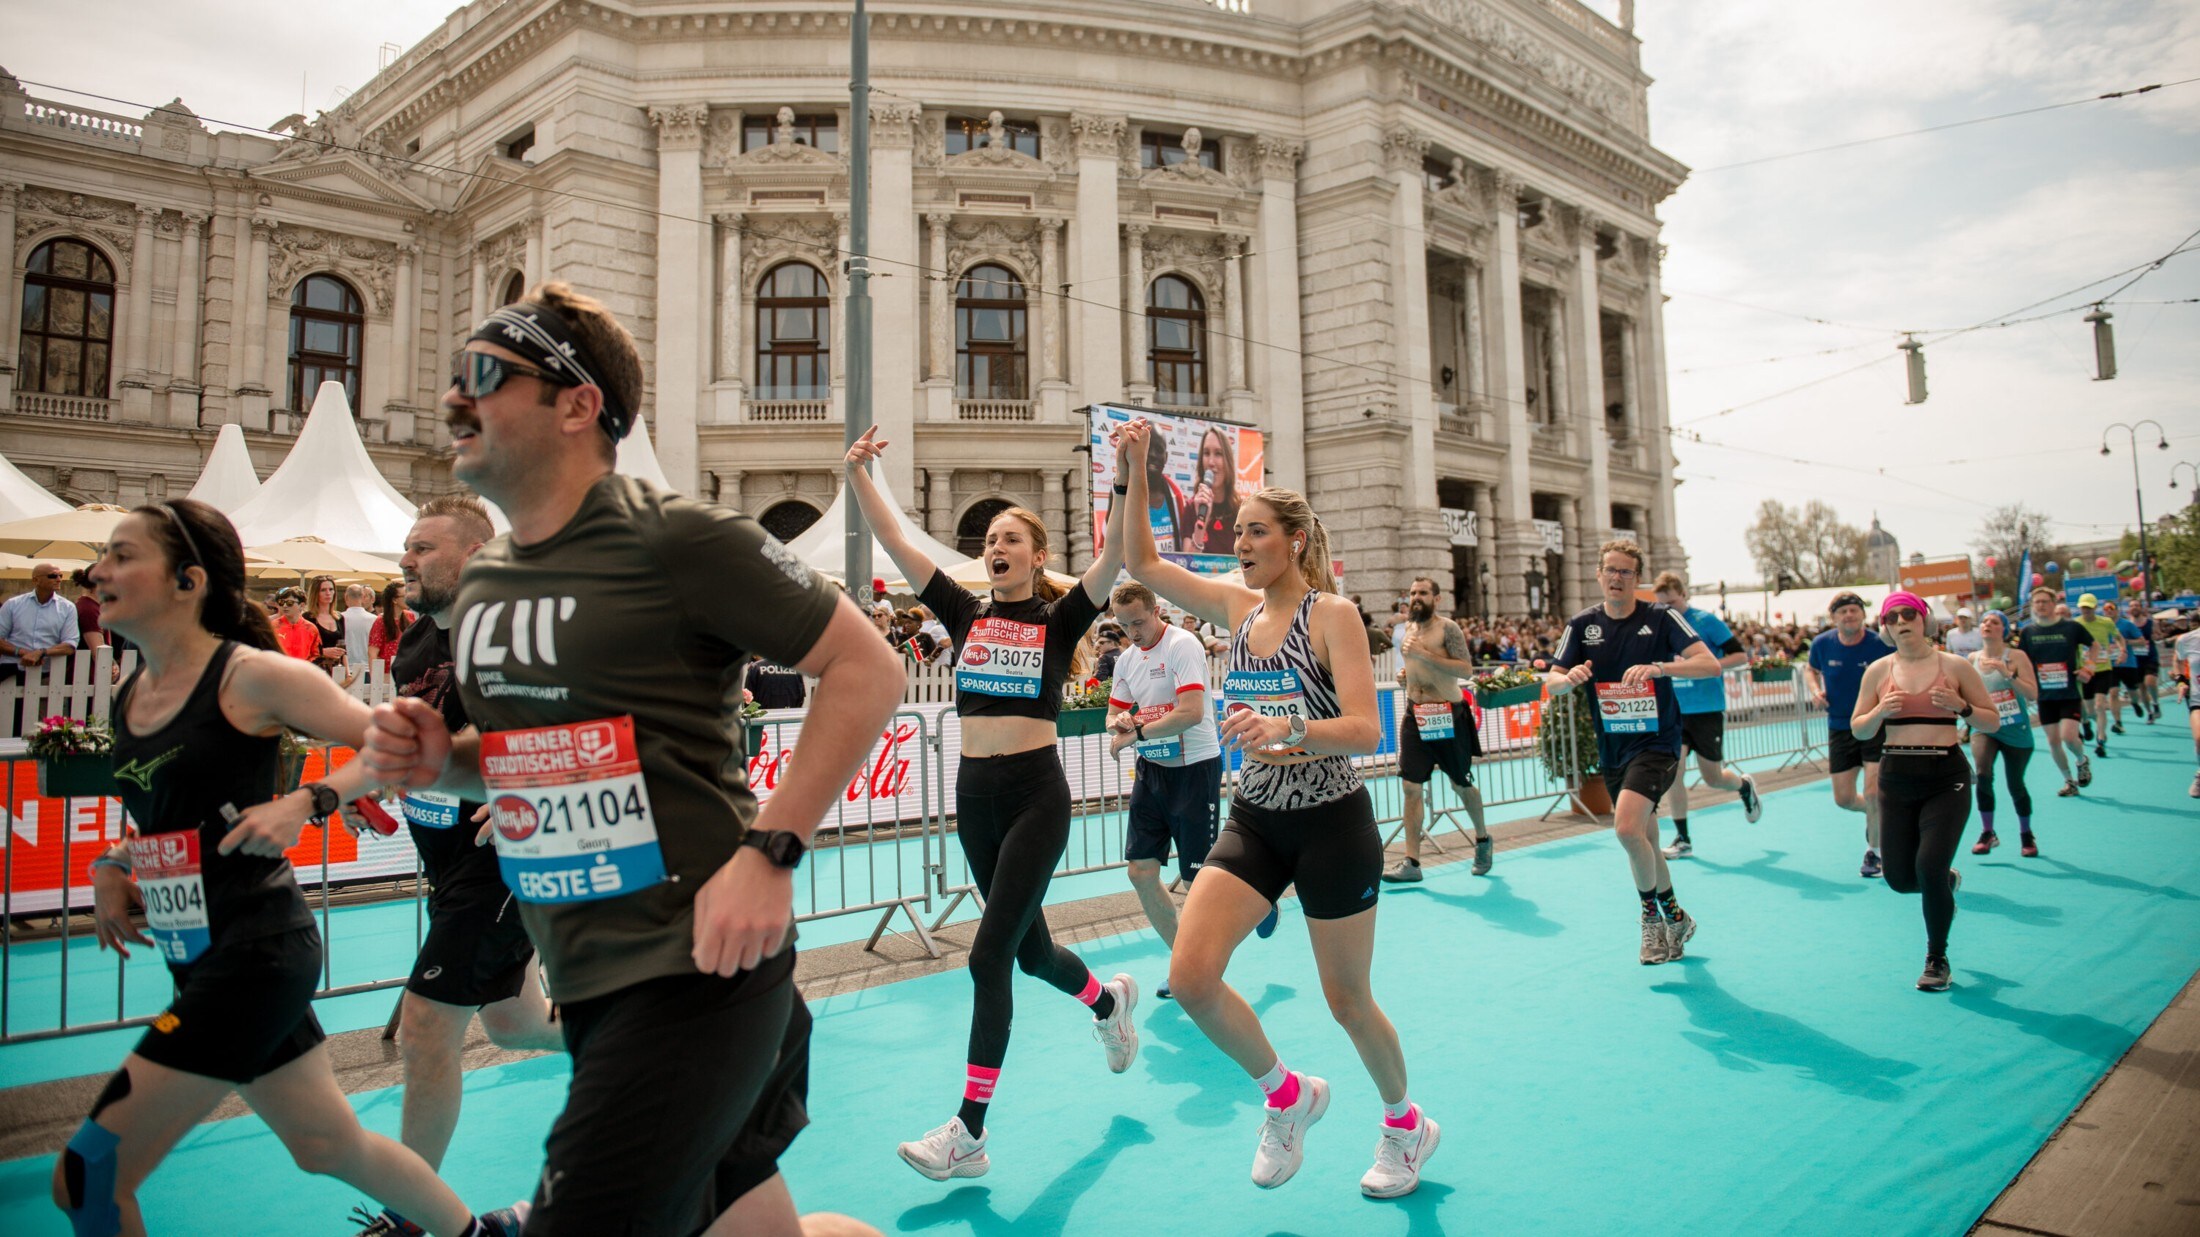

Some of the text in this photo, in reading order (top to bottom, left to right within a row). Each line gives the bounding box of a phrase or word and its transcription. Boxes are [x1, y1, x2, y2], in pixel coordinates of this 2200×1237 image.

[986, 619, 1020, 632] WIENER
[964, 647, 1042, 669] Hervis 13075
[960, 677, 1022, 694] SPARKASSE
[1225, 678, 1280, 692] SPARKASSE
[1620, 699, 1656, 713] 21222
[1427, 715, 1452, 726] 18516
[1610, 722, 1636, 732] ERSTE
[505, 728, 574, 754] WIENER
[1144, 748, 1163, 758] ERSTE
[485, 748, 579, 776] STÄDTISCHE
[538, 782, 646, 835] 21104
[576, 837, 611, 851] Georg
[518, 868, 589, 899] ERSTE
